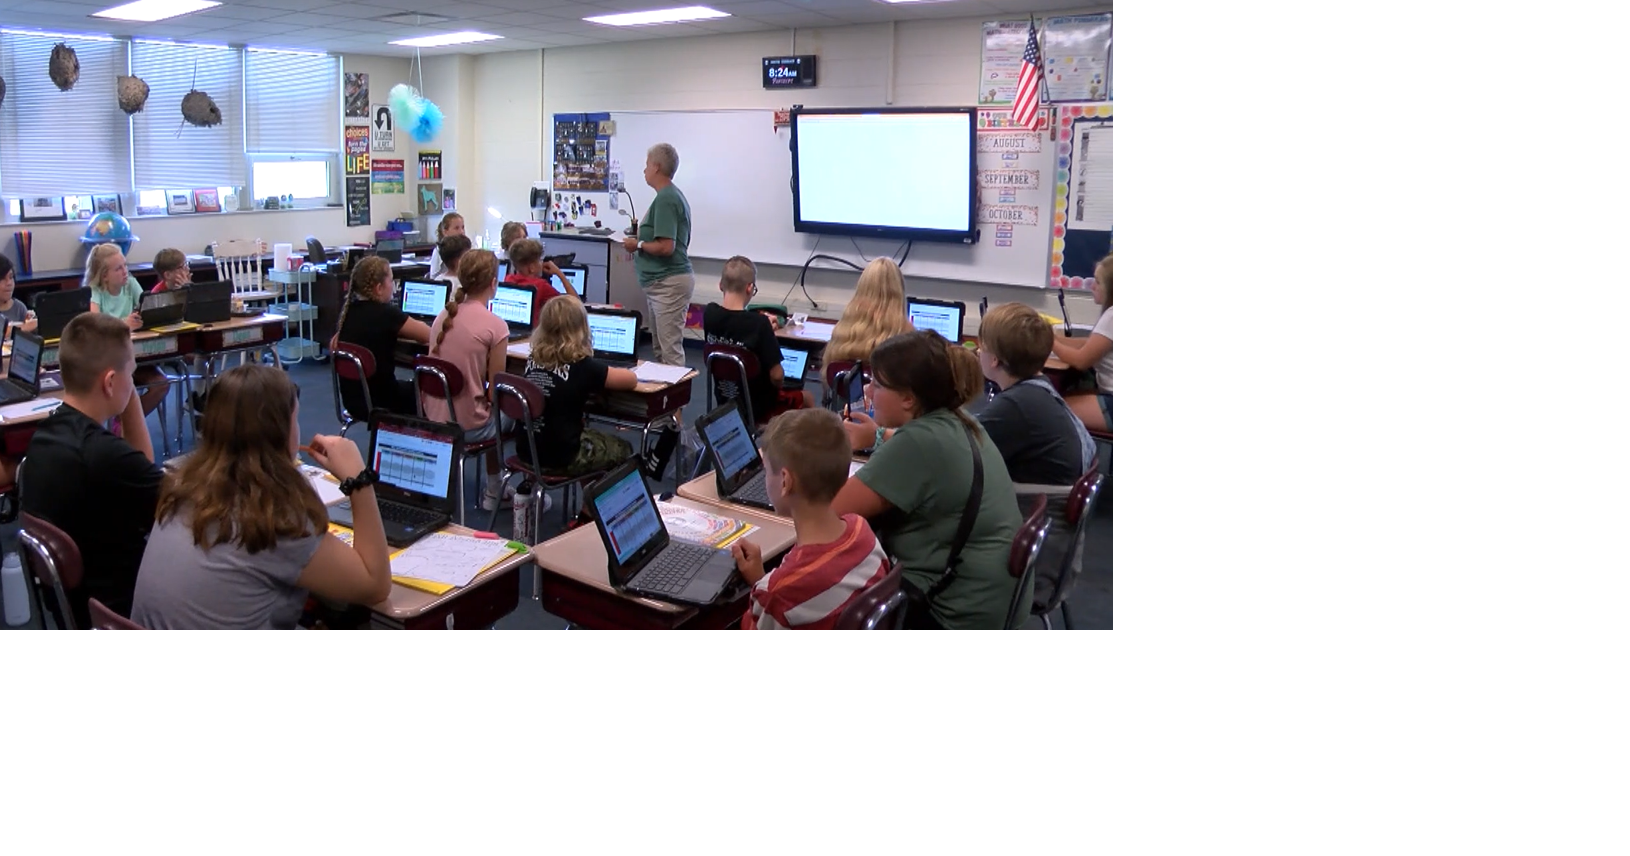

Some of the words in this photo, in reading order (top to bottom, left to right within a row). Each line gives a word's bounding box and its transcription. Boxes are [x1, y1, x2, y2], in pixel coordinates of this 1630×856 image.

[993, 138, 1025, 148] AUGUST
[346, 153, 369, 174] LIFE
[985, 174, 1029, 184] SEPTEMBER
[988, 209, 1023, 220] OCTOBER
